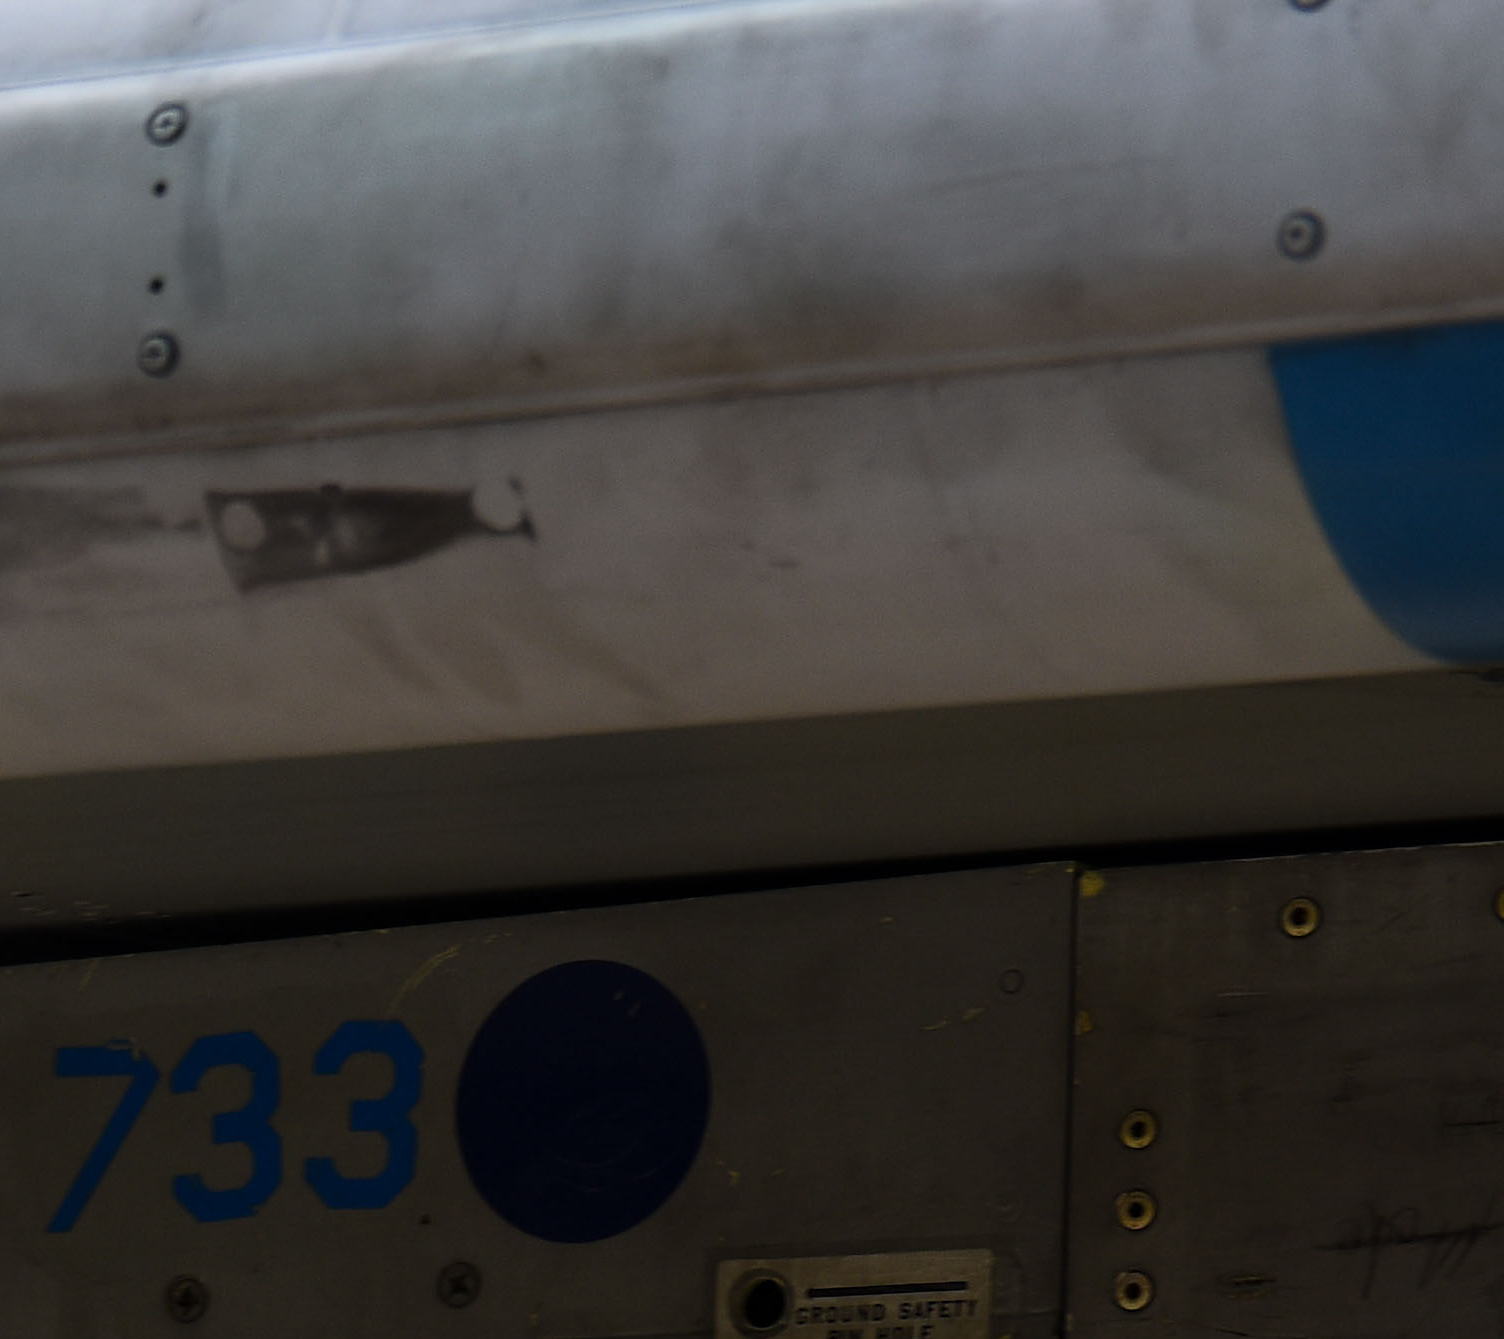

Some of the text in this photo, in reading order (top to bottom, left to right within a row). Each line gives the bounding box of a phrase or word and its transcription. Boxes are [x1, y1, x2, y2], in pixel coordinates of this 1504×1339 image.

[46, 1018, 426, 1234] 733
[796, 1299, 979, 1325] GROUND SAFETY
